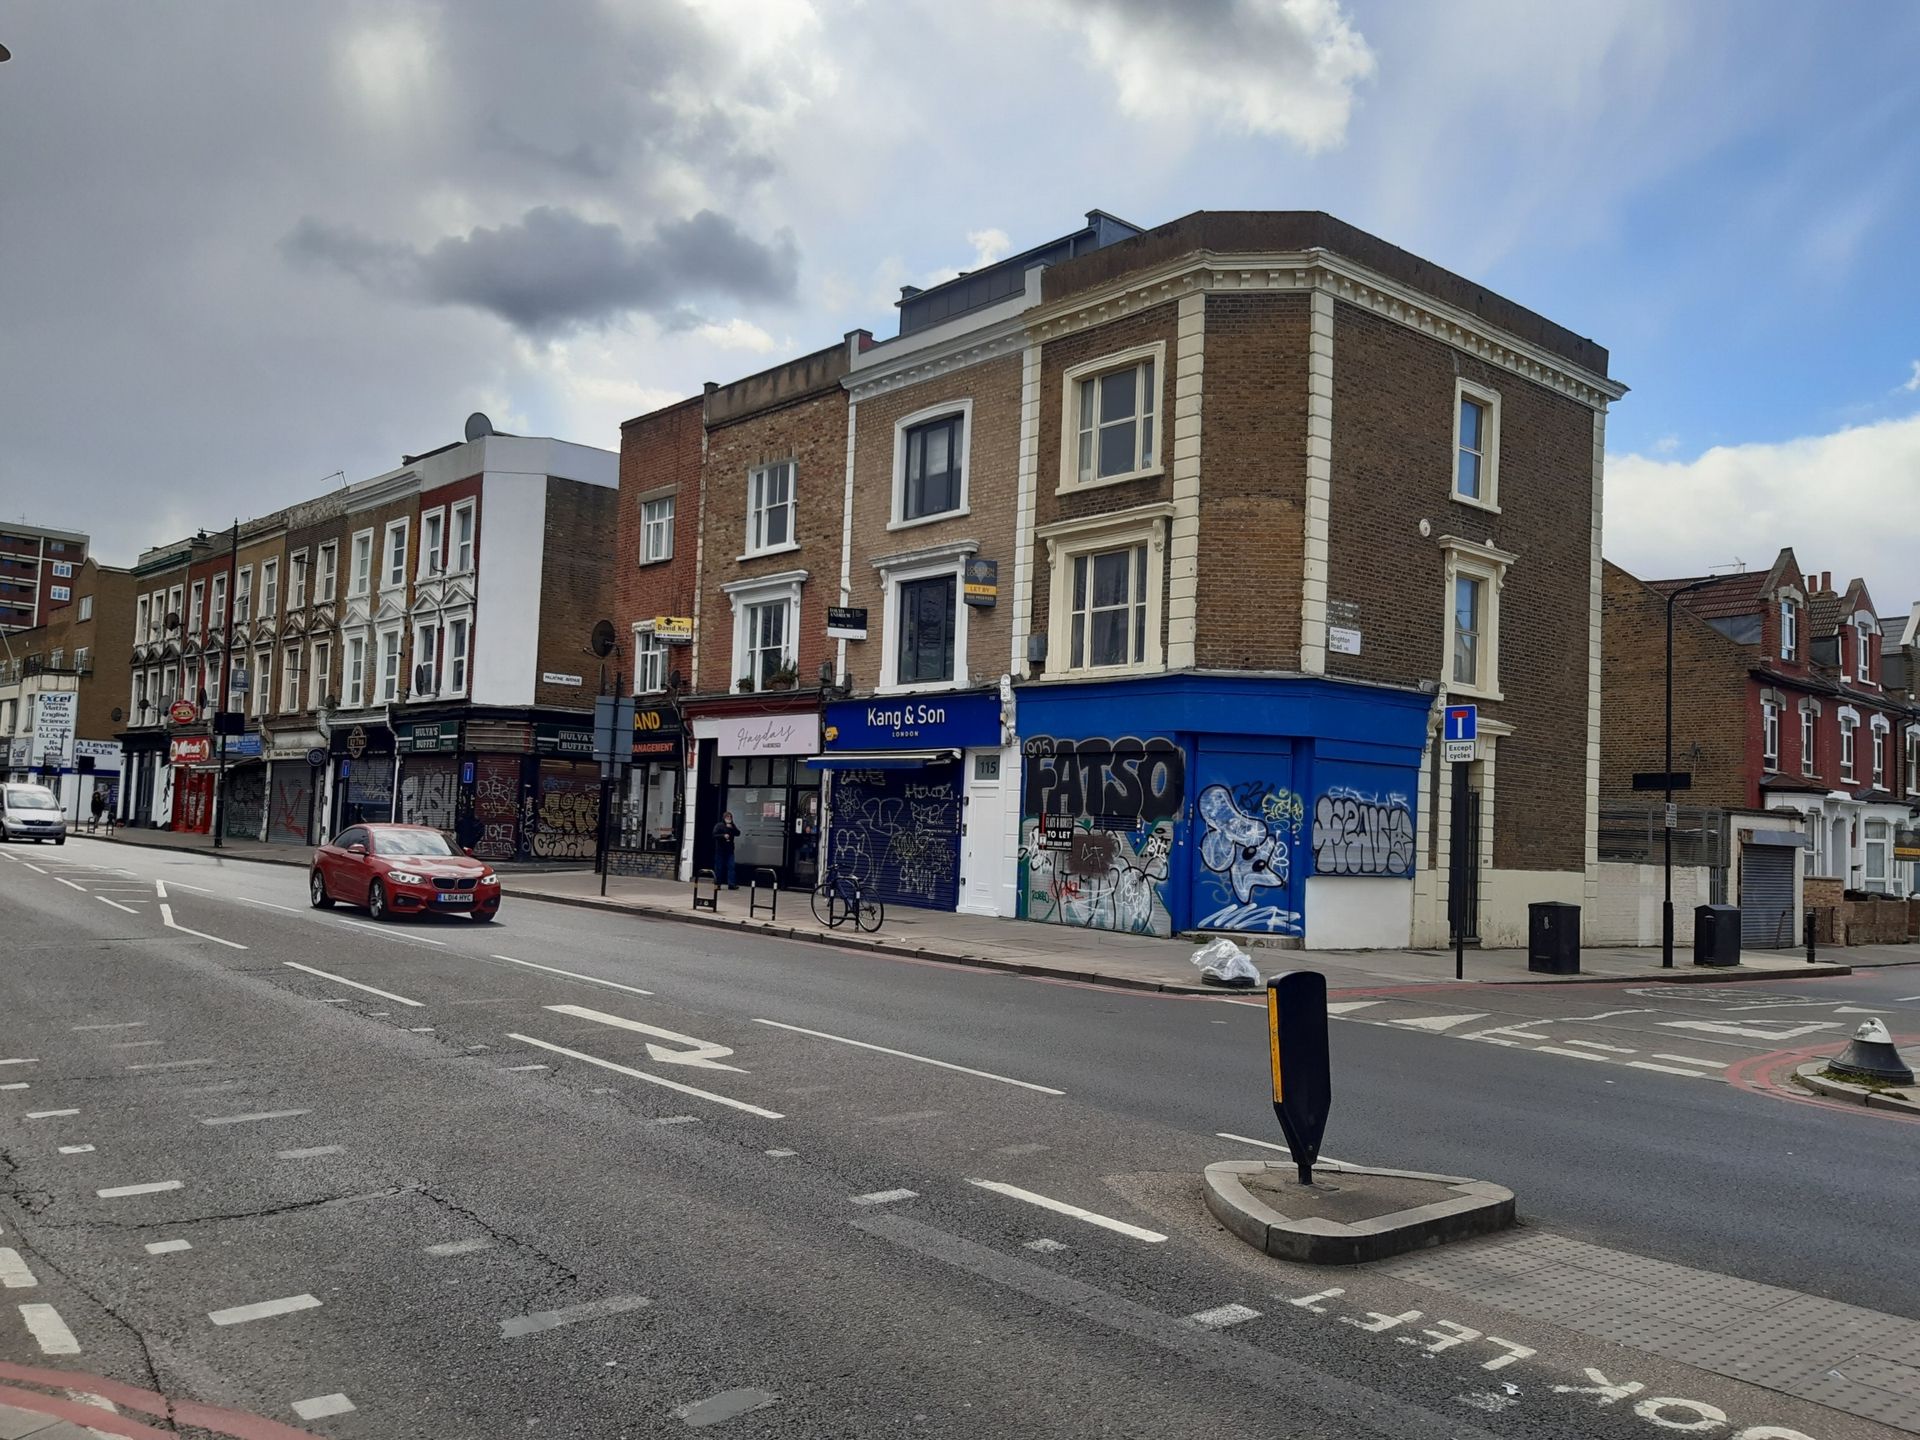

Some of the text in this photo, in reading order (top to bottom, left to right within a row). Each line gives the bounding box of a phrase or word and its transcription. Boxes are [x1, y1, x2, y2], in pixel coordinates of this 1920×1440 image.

[657, 623, 690, 633] David Key
[1330, 634, 1350, 644] Brighton
[1330, 642, 1343, 650] Road
[39, 694, 72, 703] Excel
[634, 711, 660, 730] AND
[867, 704, 945, 730] Kang & Son
[415, 727, 438, 737] HULYA'S
[892, 730, 919, 738] LONDON
[87, 741, 119, 749] Levels
[416, 739, 437, 749] BUFFET
[981, 761, 997, 774] 115
[1024, 735, 1186, 823] FATSO
[1046, 830, 1071, 839] TO LET
